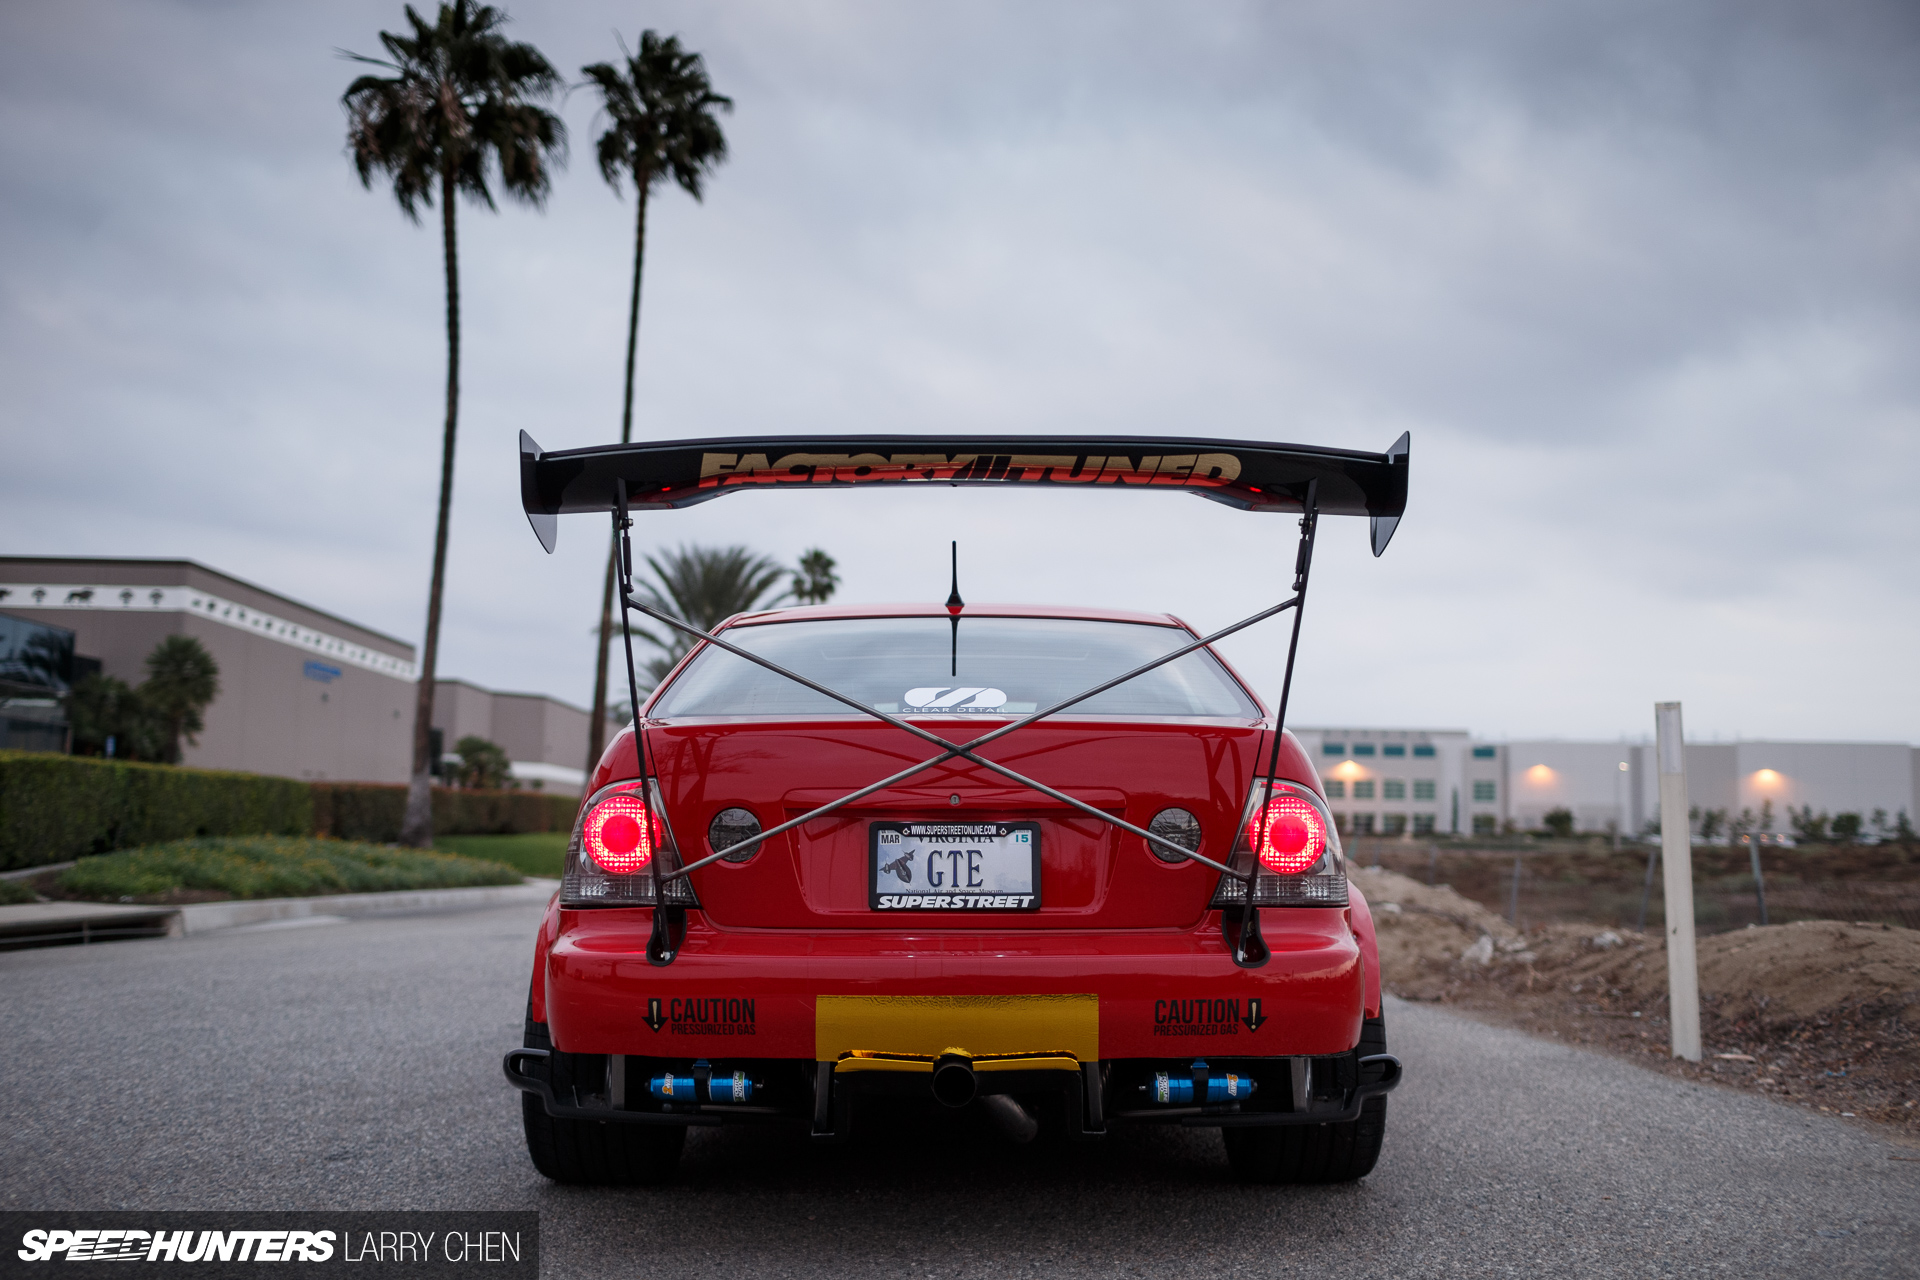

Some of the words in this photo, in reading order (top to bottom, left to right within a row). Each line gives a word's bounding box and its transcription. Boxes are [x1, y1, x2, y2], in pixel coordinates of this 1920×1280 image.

[911, 825, 996, 835] WWW.SUPERSTREETONLINE.COM
[881, 834, 900, 844] MAR
[1015, 834, 1029, 843] 15
[927, 850, 984, 888] GTE
[878, 895, 1034, 909] SUPERSTREET
[670, 998, 756, 1023] CAUTION
[1154, 999, 1240, 1024] CAUTION
[671, 1024, 735, 1035] PRESSURIZED
[737, 1023, 756, 1035] GAS
[1153, 1025, 1218, 1036] PRESSURIZED
[1220, 1024, 1239, 1035] GAS
